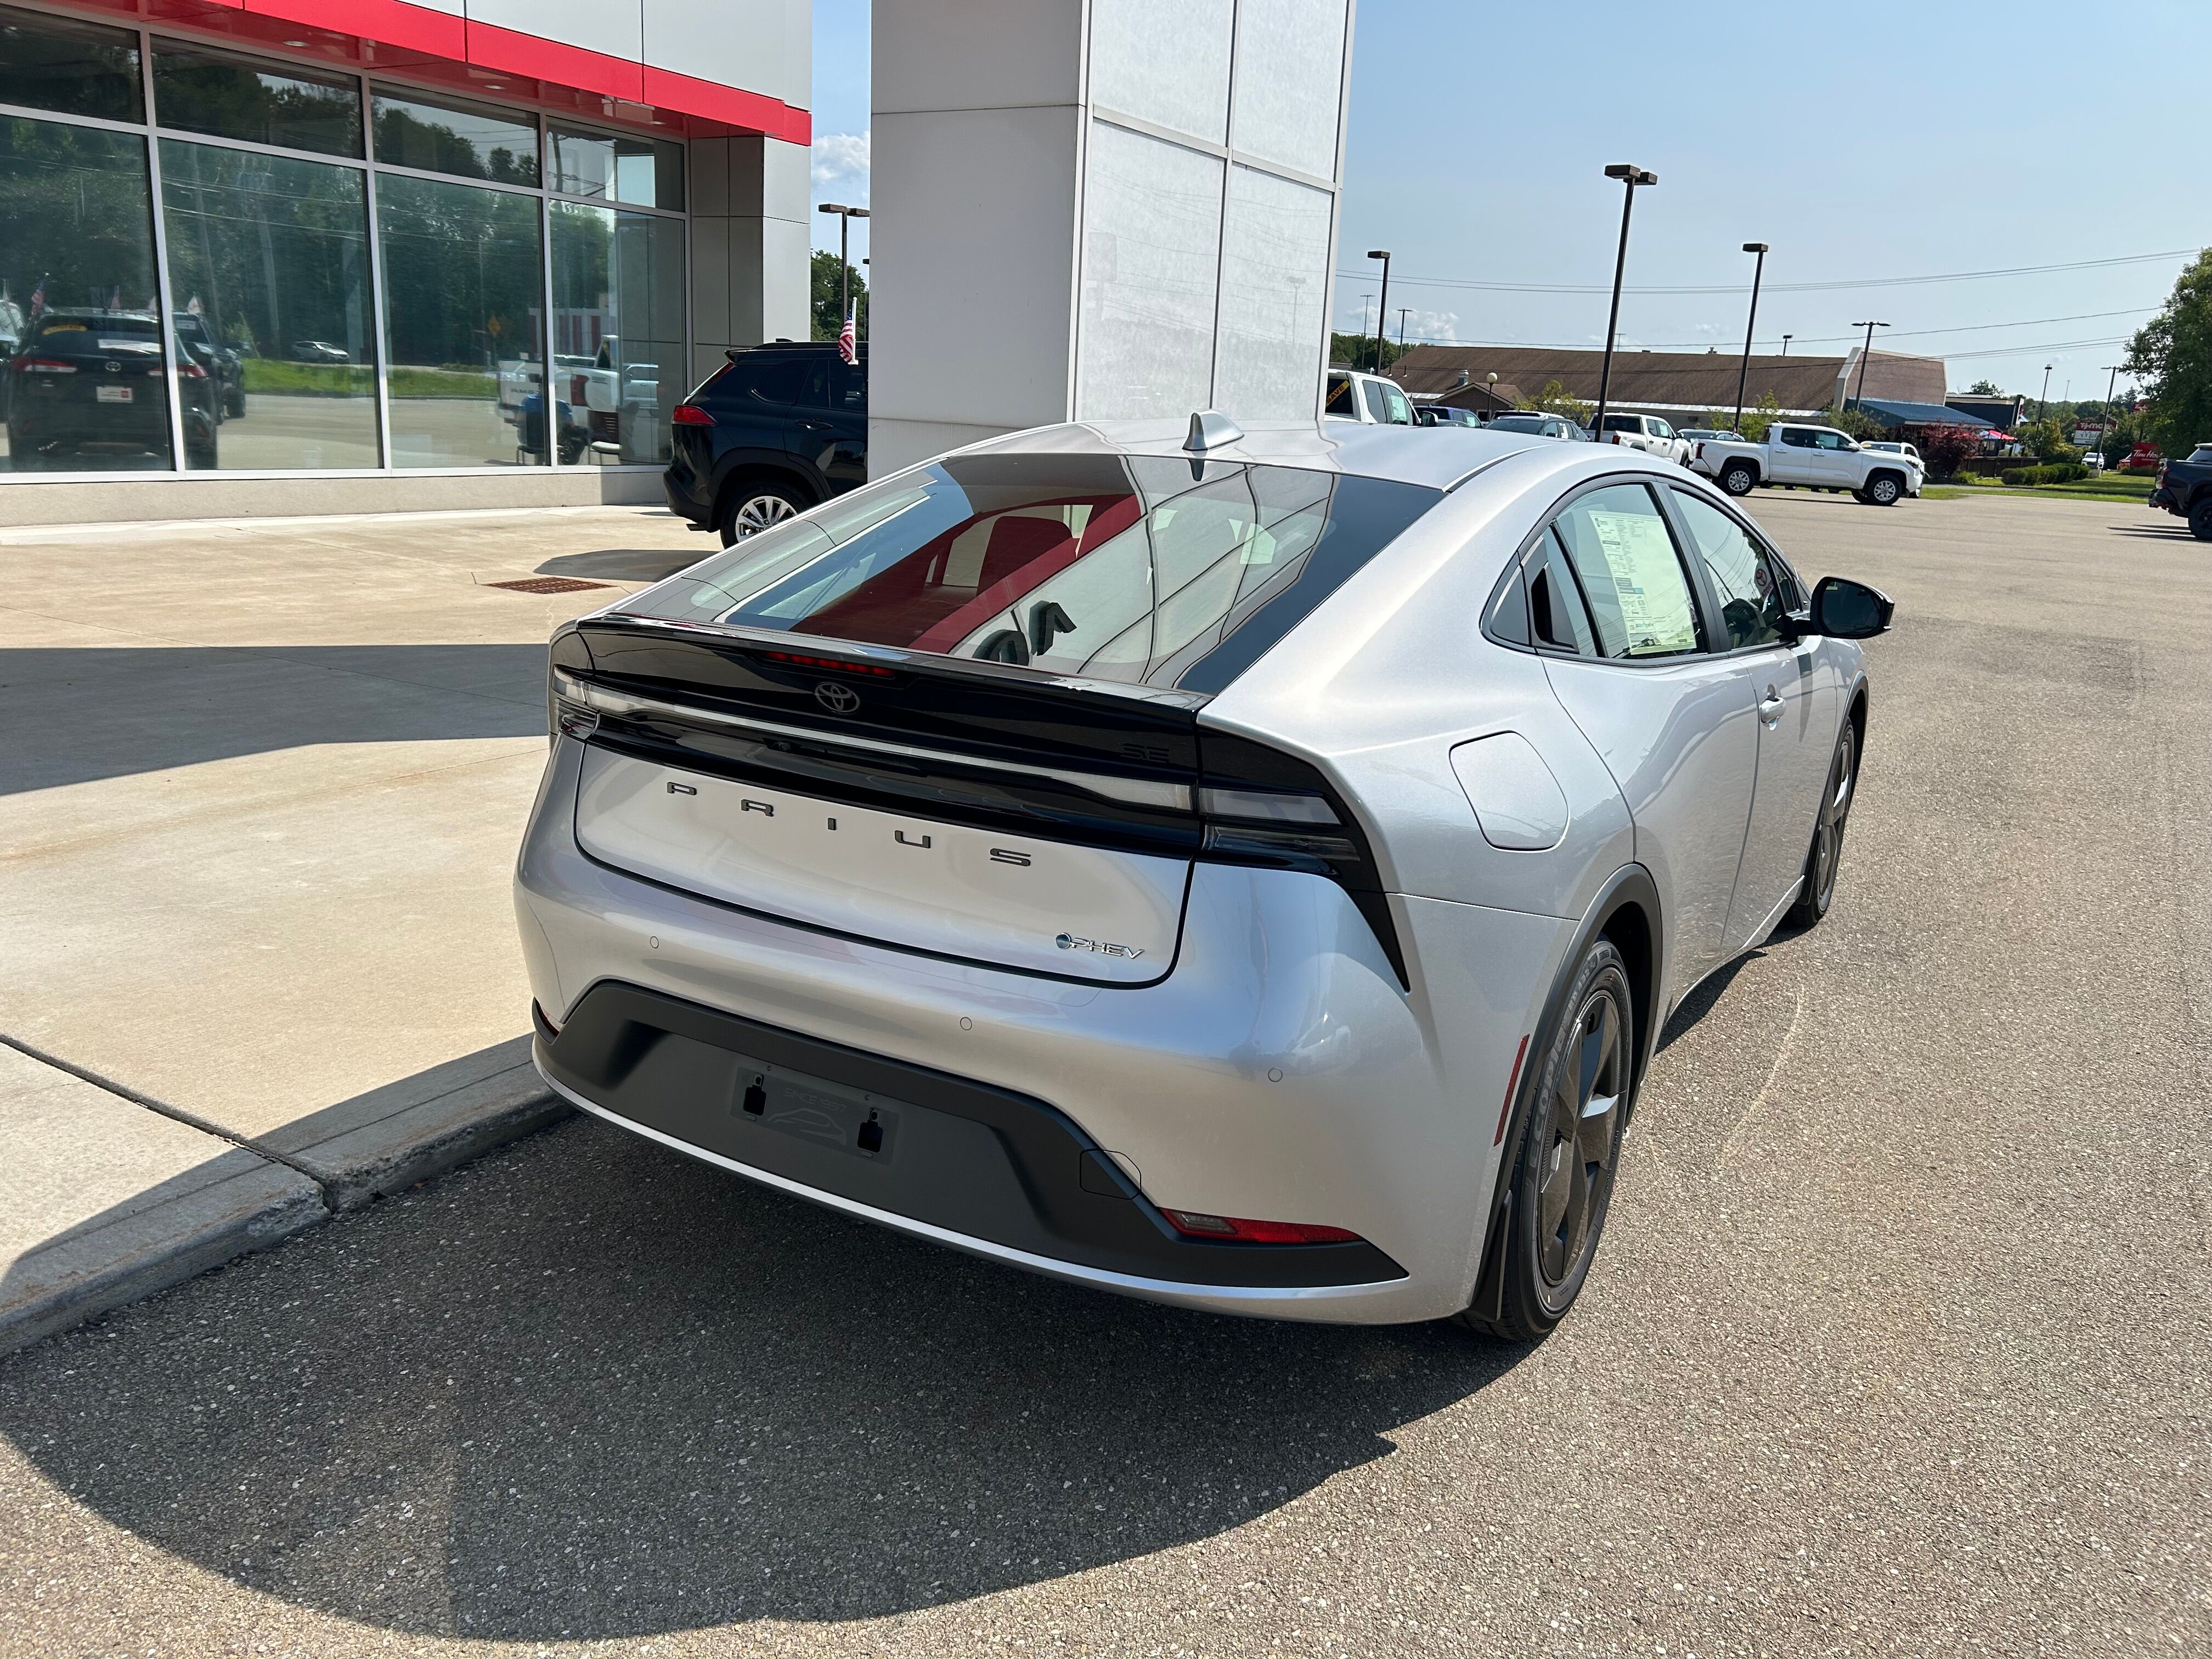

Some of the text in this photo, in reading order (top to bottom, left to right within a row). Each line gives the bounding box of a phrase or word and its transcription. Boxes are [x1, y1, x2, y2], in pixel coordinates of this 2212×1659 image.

[1327, 385, 1344, 404] SAVE
[1120, 742, 1170, 763] SE
[667, 781, 1031, 867] PRIUS
[1071, 937, 1145, 959] PHEV
[783, 1088, 846, 1113] SINCE 1997
